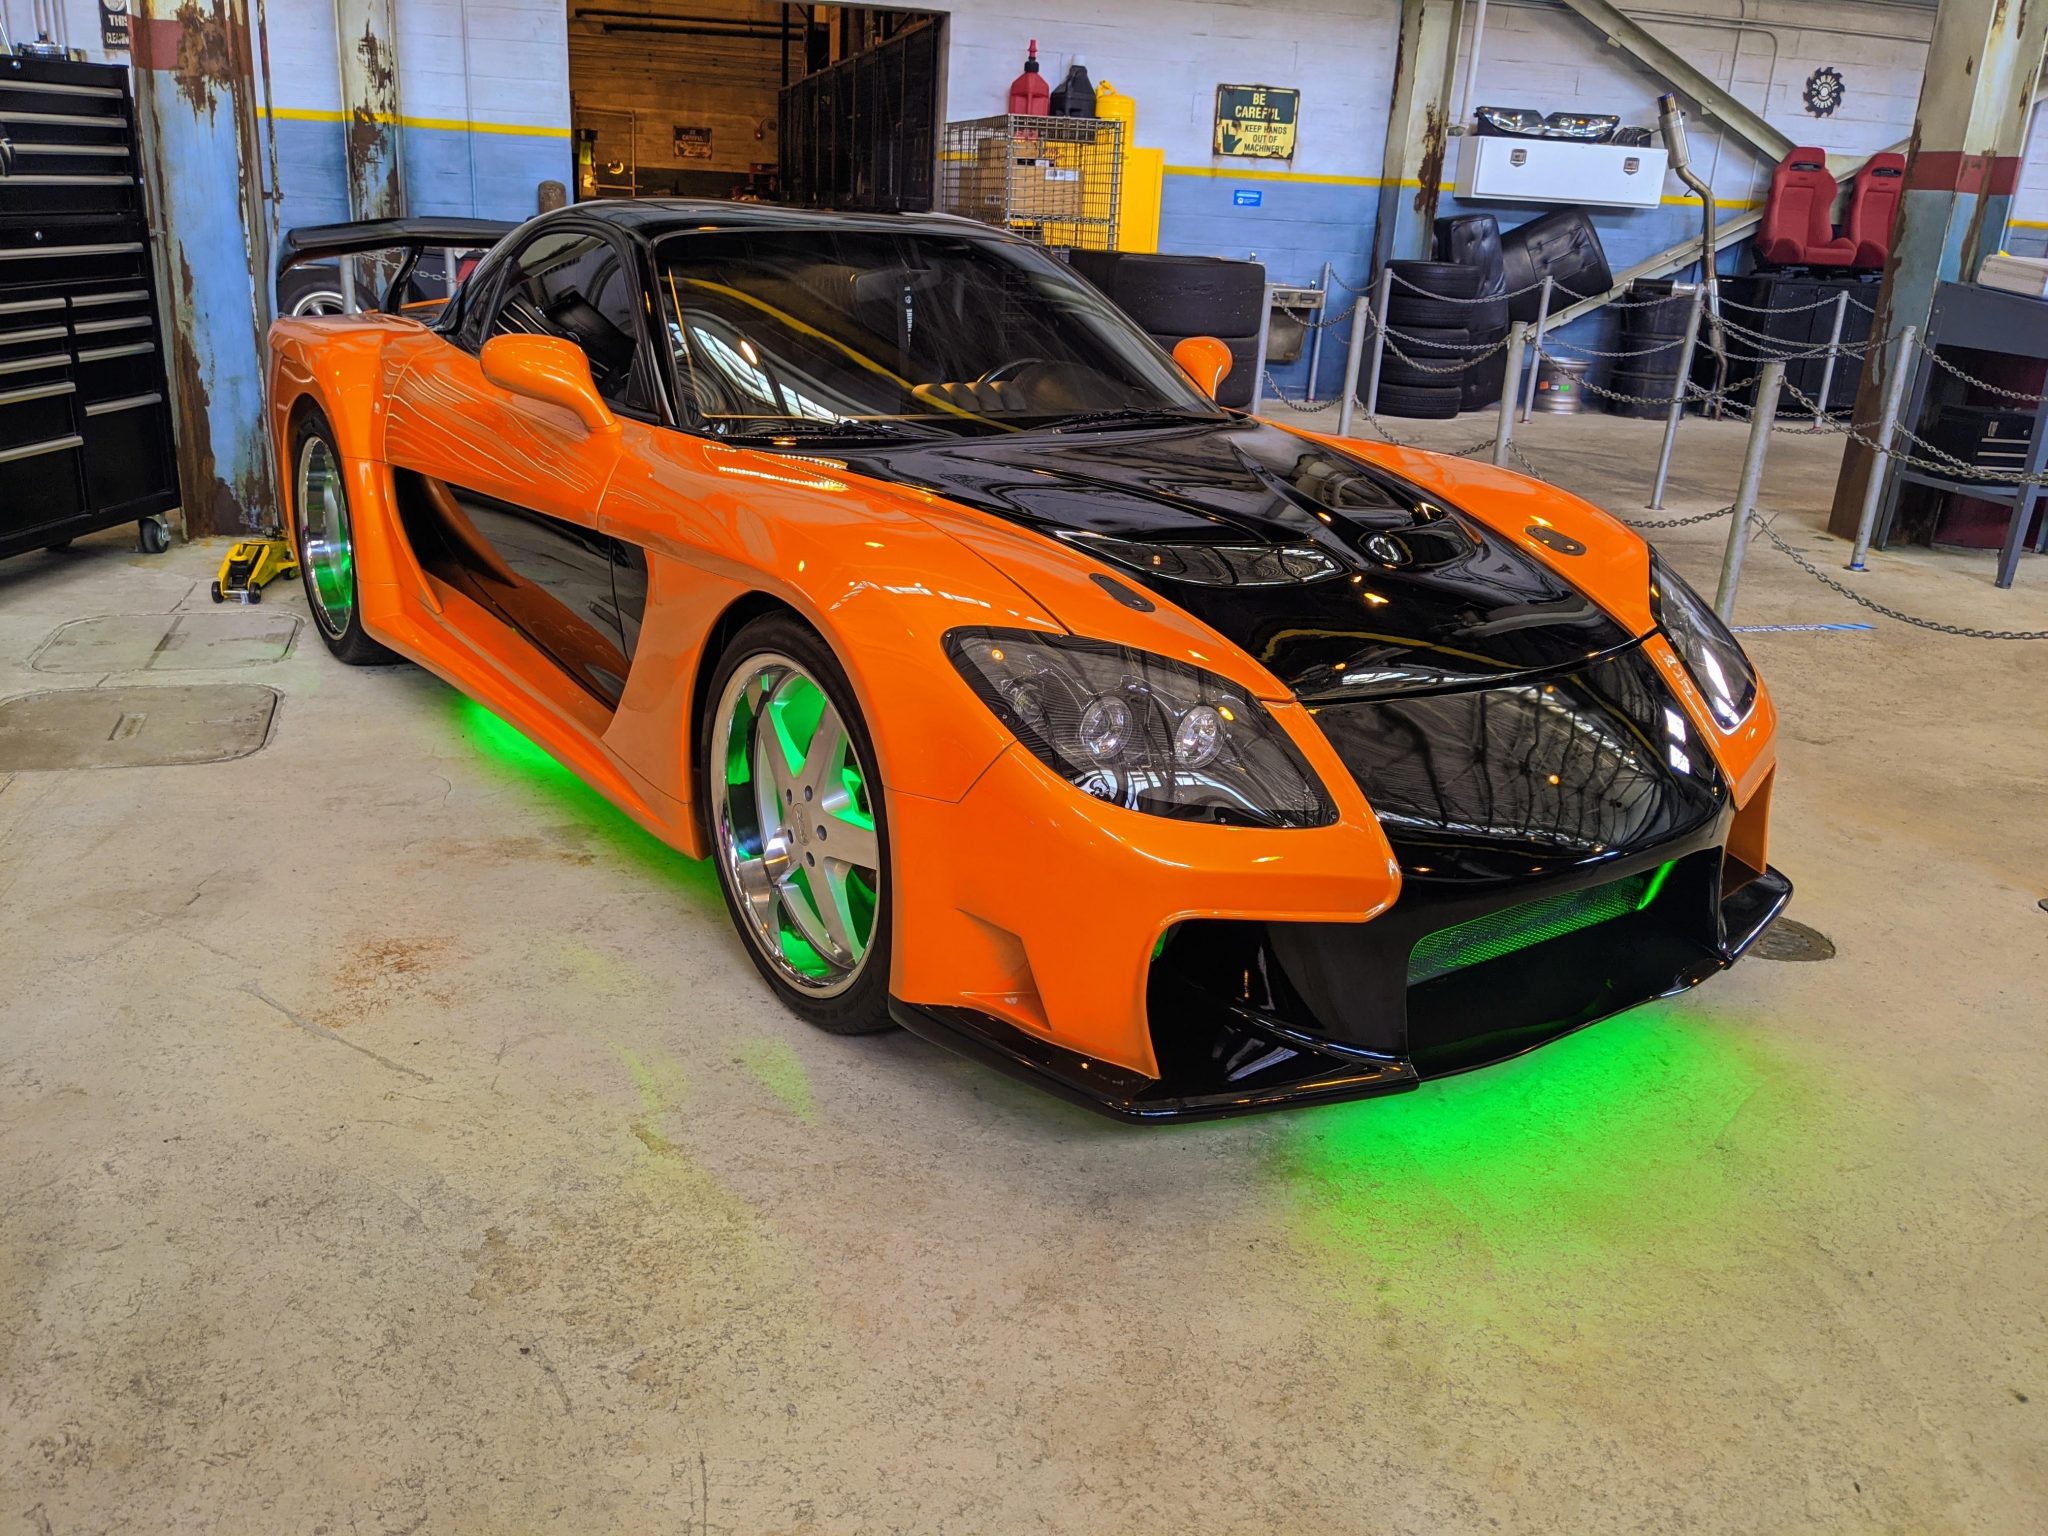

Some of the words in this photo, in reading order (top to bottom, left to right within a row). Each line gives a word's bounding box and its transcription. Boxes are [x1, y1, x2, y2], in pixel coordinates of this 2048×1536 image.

[108, 14, 128, 27] THIS
[1252, 92, 1266, 105] BE
[1264, 126, 1287, 135] HANDS
[1252, 134, 1266, 143] OUT
[1268, 135, 1278, 144] OF
[1244, 143, 1284, 153] MACHINERY
